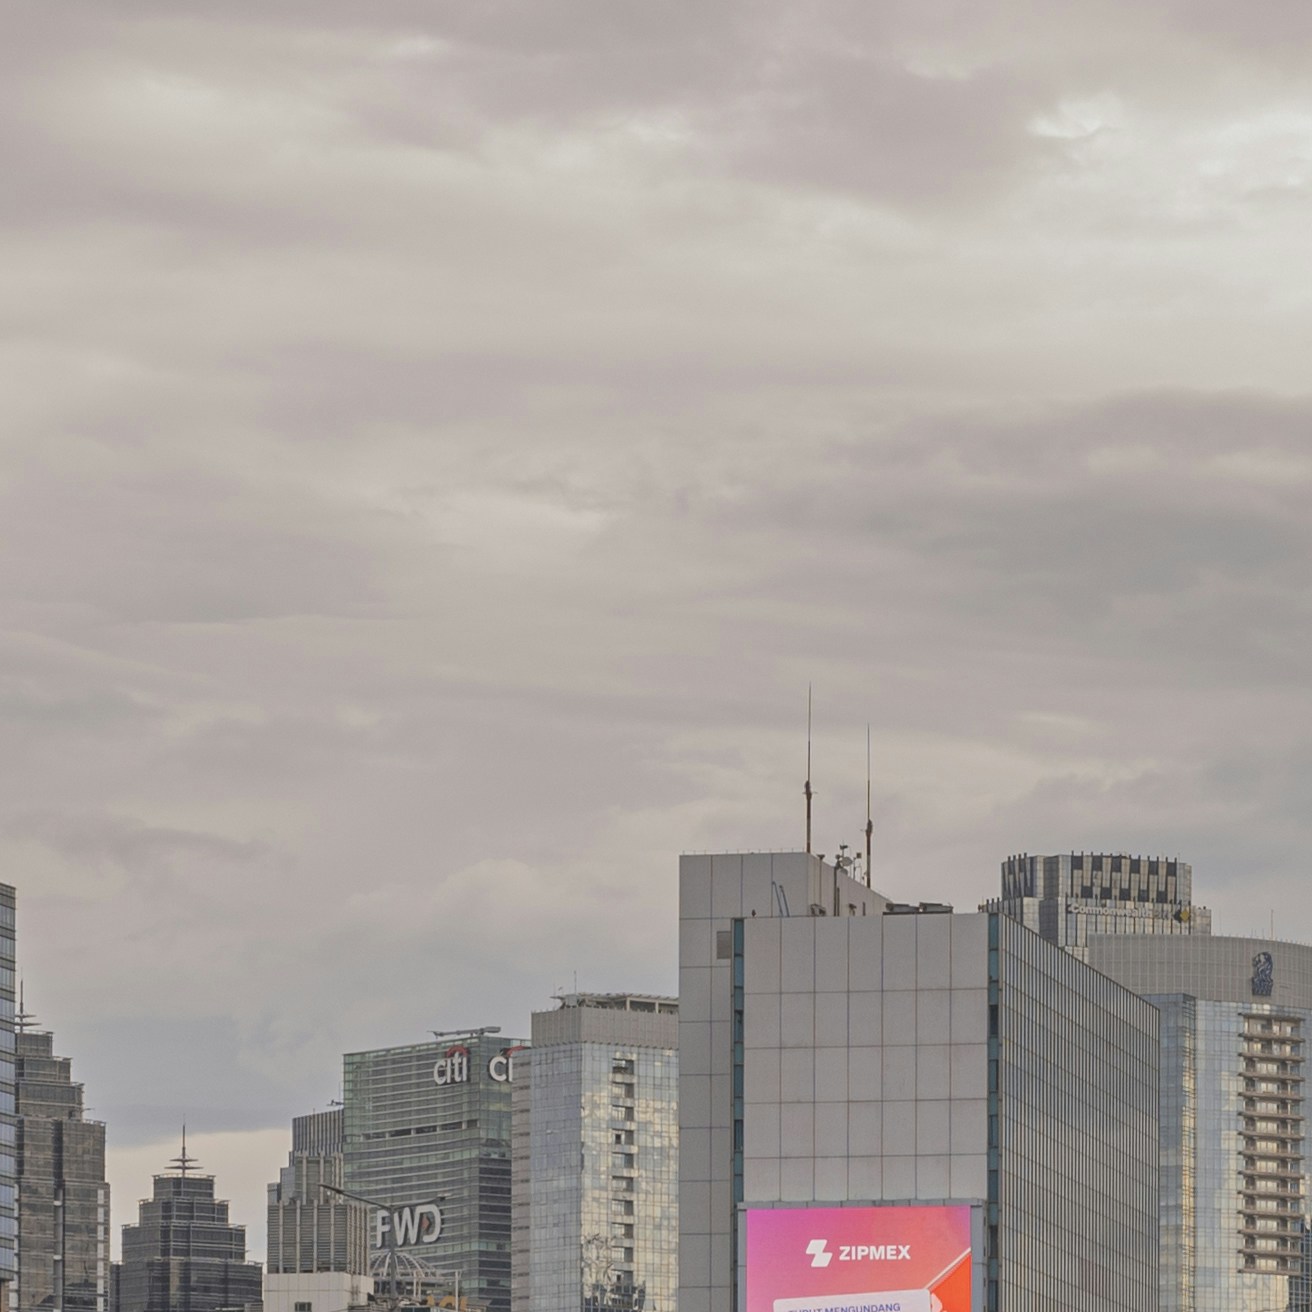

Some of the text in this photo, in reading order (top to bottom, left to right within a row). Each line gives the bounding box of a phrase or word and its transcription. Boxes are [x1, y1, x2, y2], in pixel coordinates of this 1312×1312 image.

[434, 1052, 468, 1084] citi
[489, 1056, 513, 1082] ci
[376, 1204, 441, 1248] FWD
[839, 1245, 911, 1261] ZIPMEX
